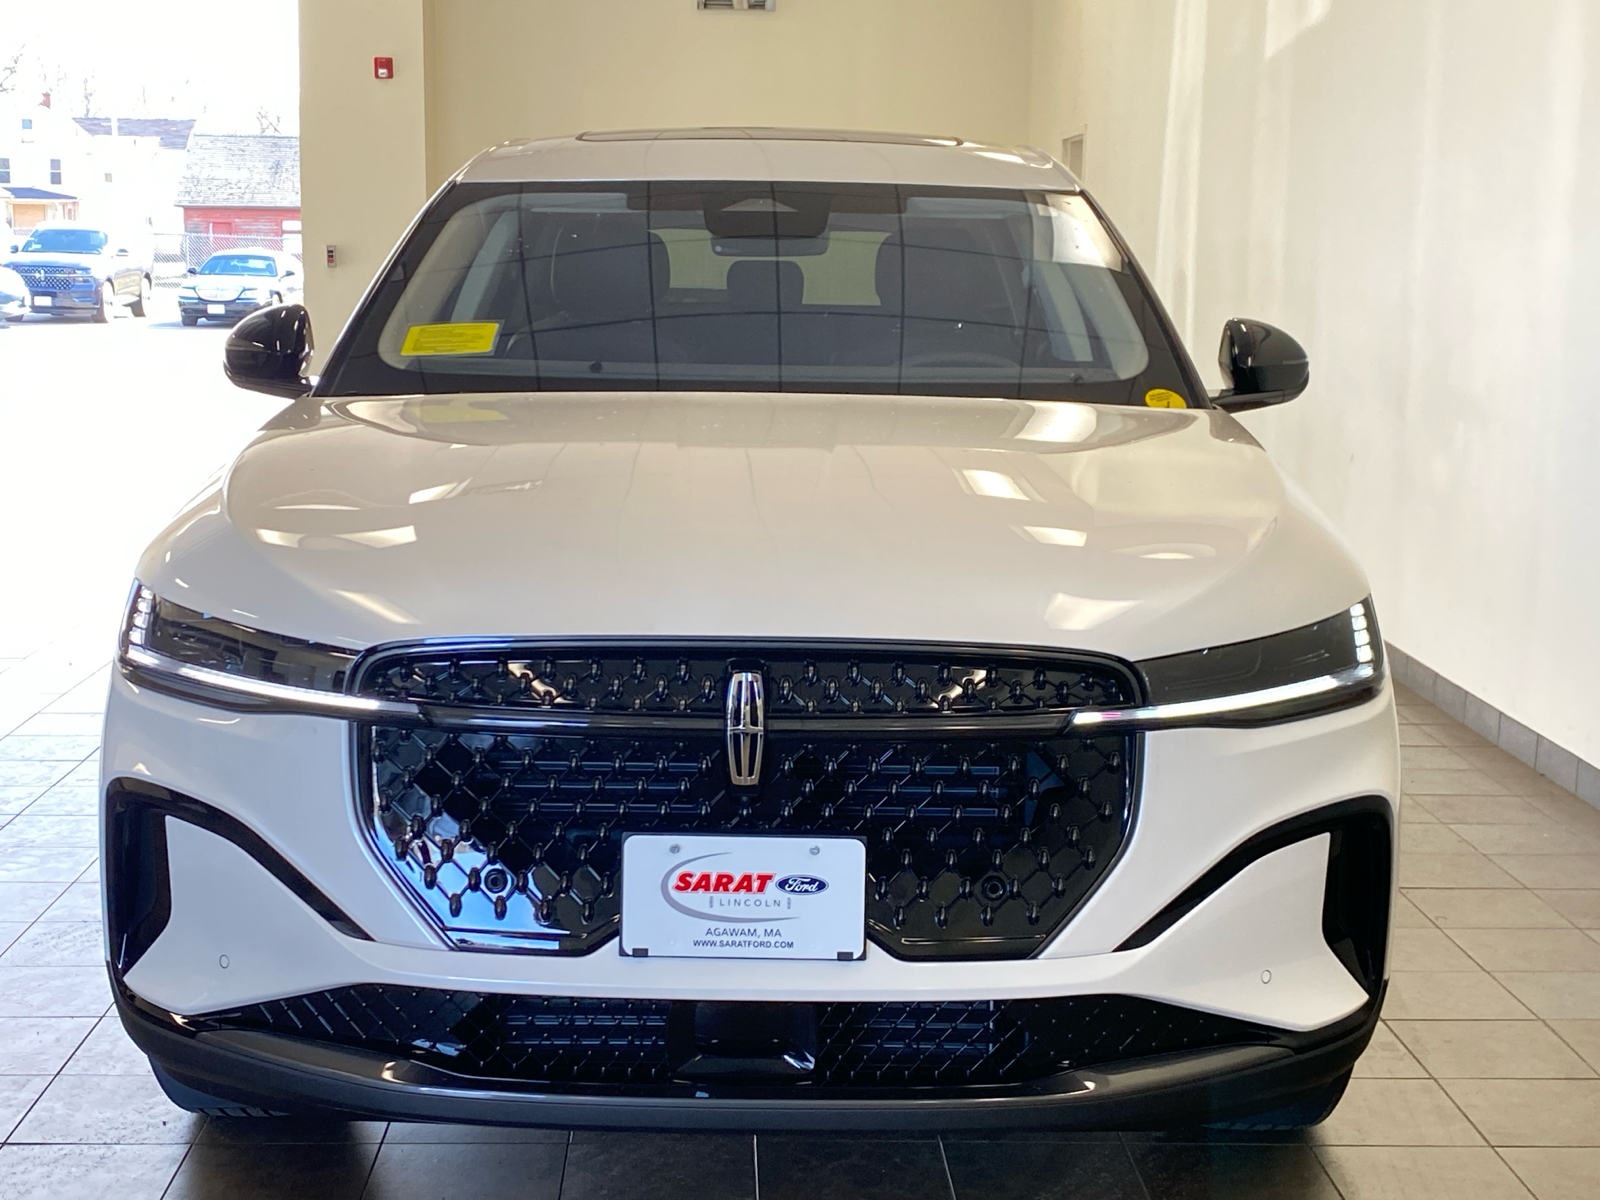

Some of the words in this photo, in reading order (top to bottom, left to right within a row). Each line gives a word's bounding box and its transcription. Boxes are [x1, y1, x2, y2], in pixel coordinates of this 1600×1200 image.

[673, 872, 775, 893] SARAT
[785, 878, 819, 892] Ford
[719, 898, 781, 908] LINCOLN
[705, 927, 761, 938] AGAWAM,
[764, 928, 782, 938] MA
[693, 939, 794, 949] WWW.SARATFORD.COM
